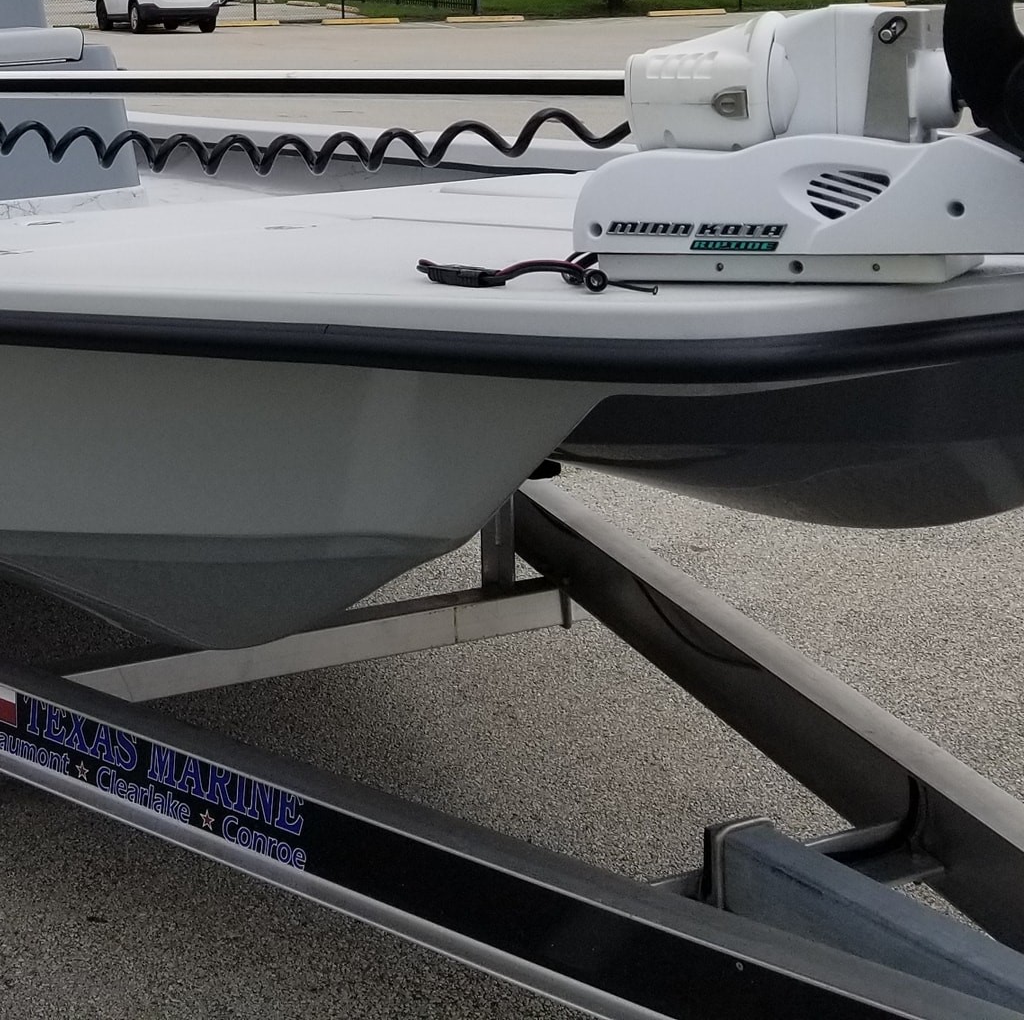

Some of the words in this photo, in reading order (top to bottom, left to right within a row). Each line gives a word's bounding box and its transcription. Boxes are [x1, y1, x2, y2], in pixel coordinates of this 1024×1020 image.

[692, 240, 777, 251] RIPTIDE
[695, 222, 788, 239] KOTA
[23, 694, 138, 771] TEXAS
[147, 741, 304, 836] MARINE
[96, 765, 191, 825] Clearlake
[222, 815, 307, 872] Conroe
